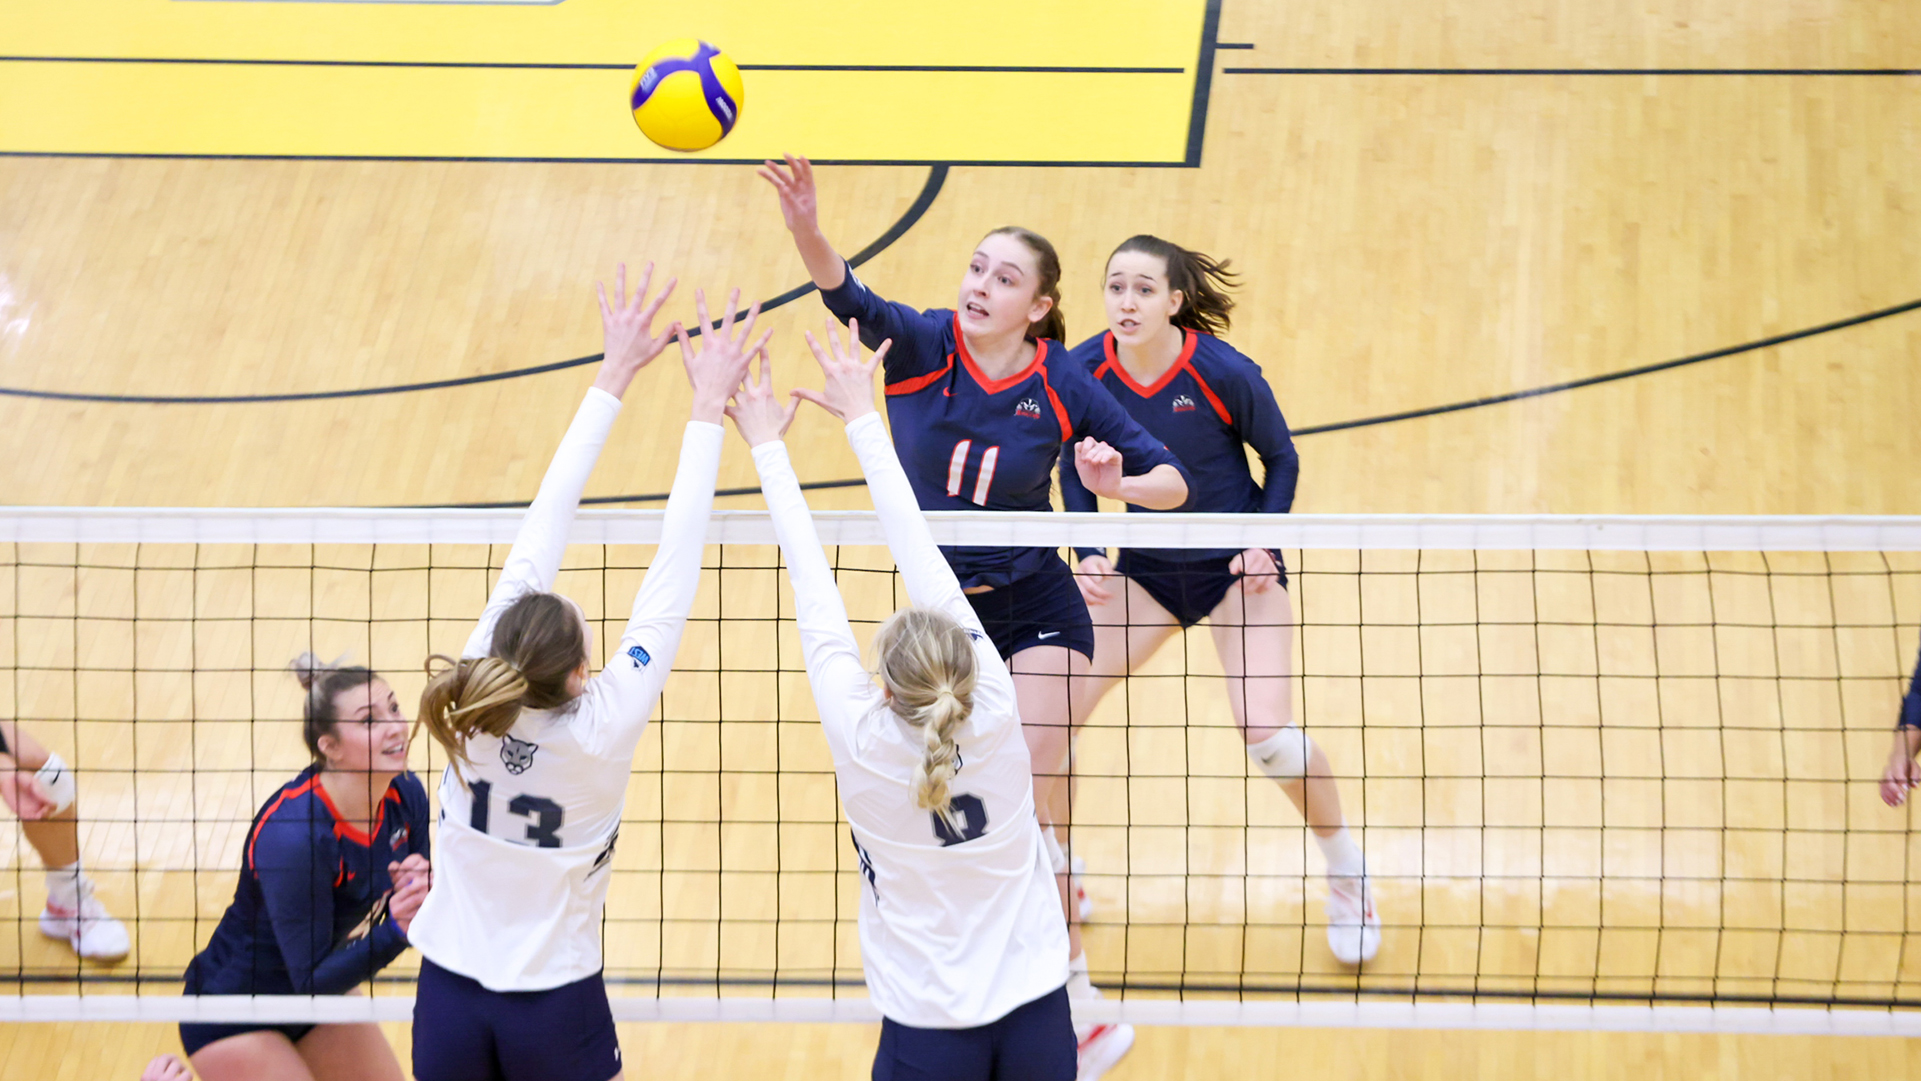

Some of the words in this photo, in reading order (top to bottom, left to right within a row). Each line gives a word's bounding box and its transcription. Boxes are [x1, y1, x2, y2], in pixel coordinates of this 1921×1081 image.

[946, 438, 1000, 507] 11
[629, 647, 649, 665] WEST
[467, 778, 566, 848] 13
